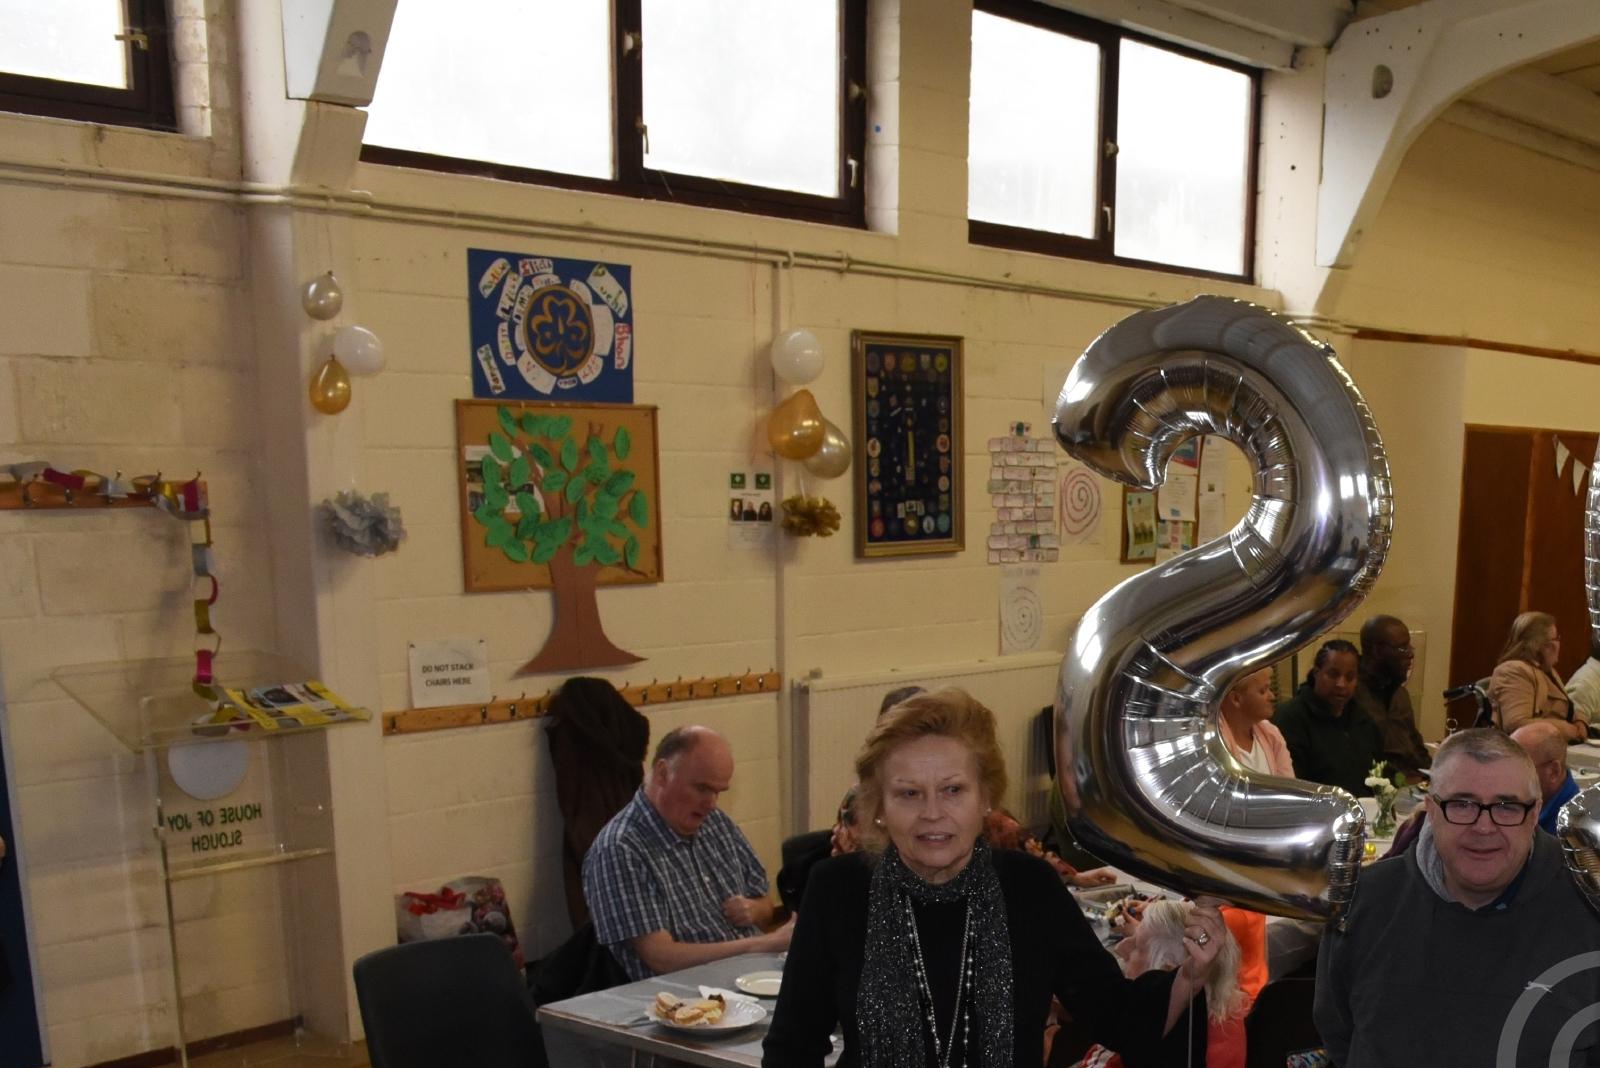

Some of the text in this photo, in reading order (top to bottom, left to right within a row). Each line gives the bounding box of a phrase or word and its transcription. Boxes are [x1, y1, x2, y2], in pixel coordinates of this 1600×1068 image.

[422, 665, 433, 674] DO
[434, 664, 449, 673] NOT
[425, 678, 451, 687] CHAIRS
